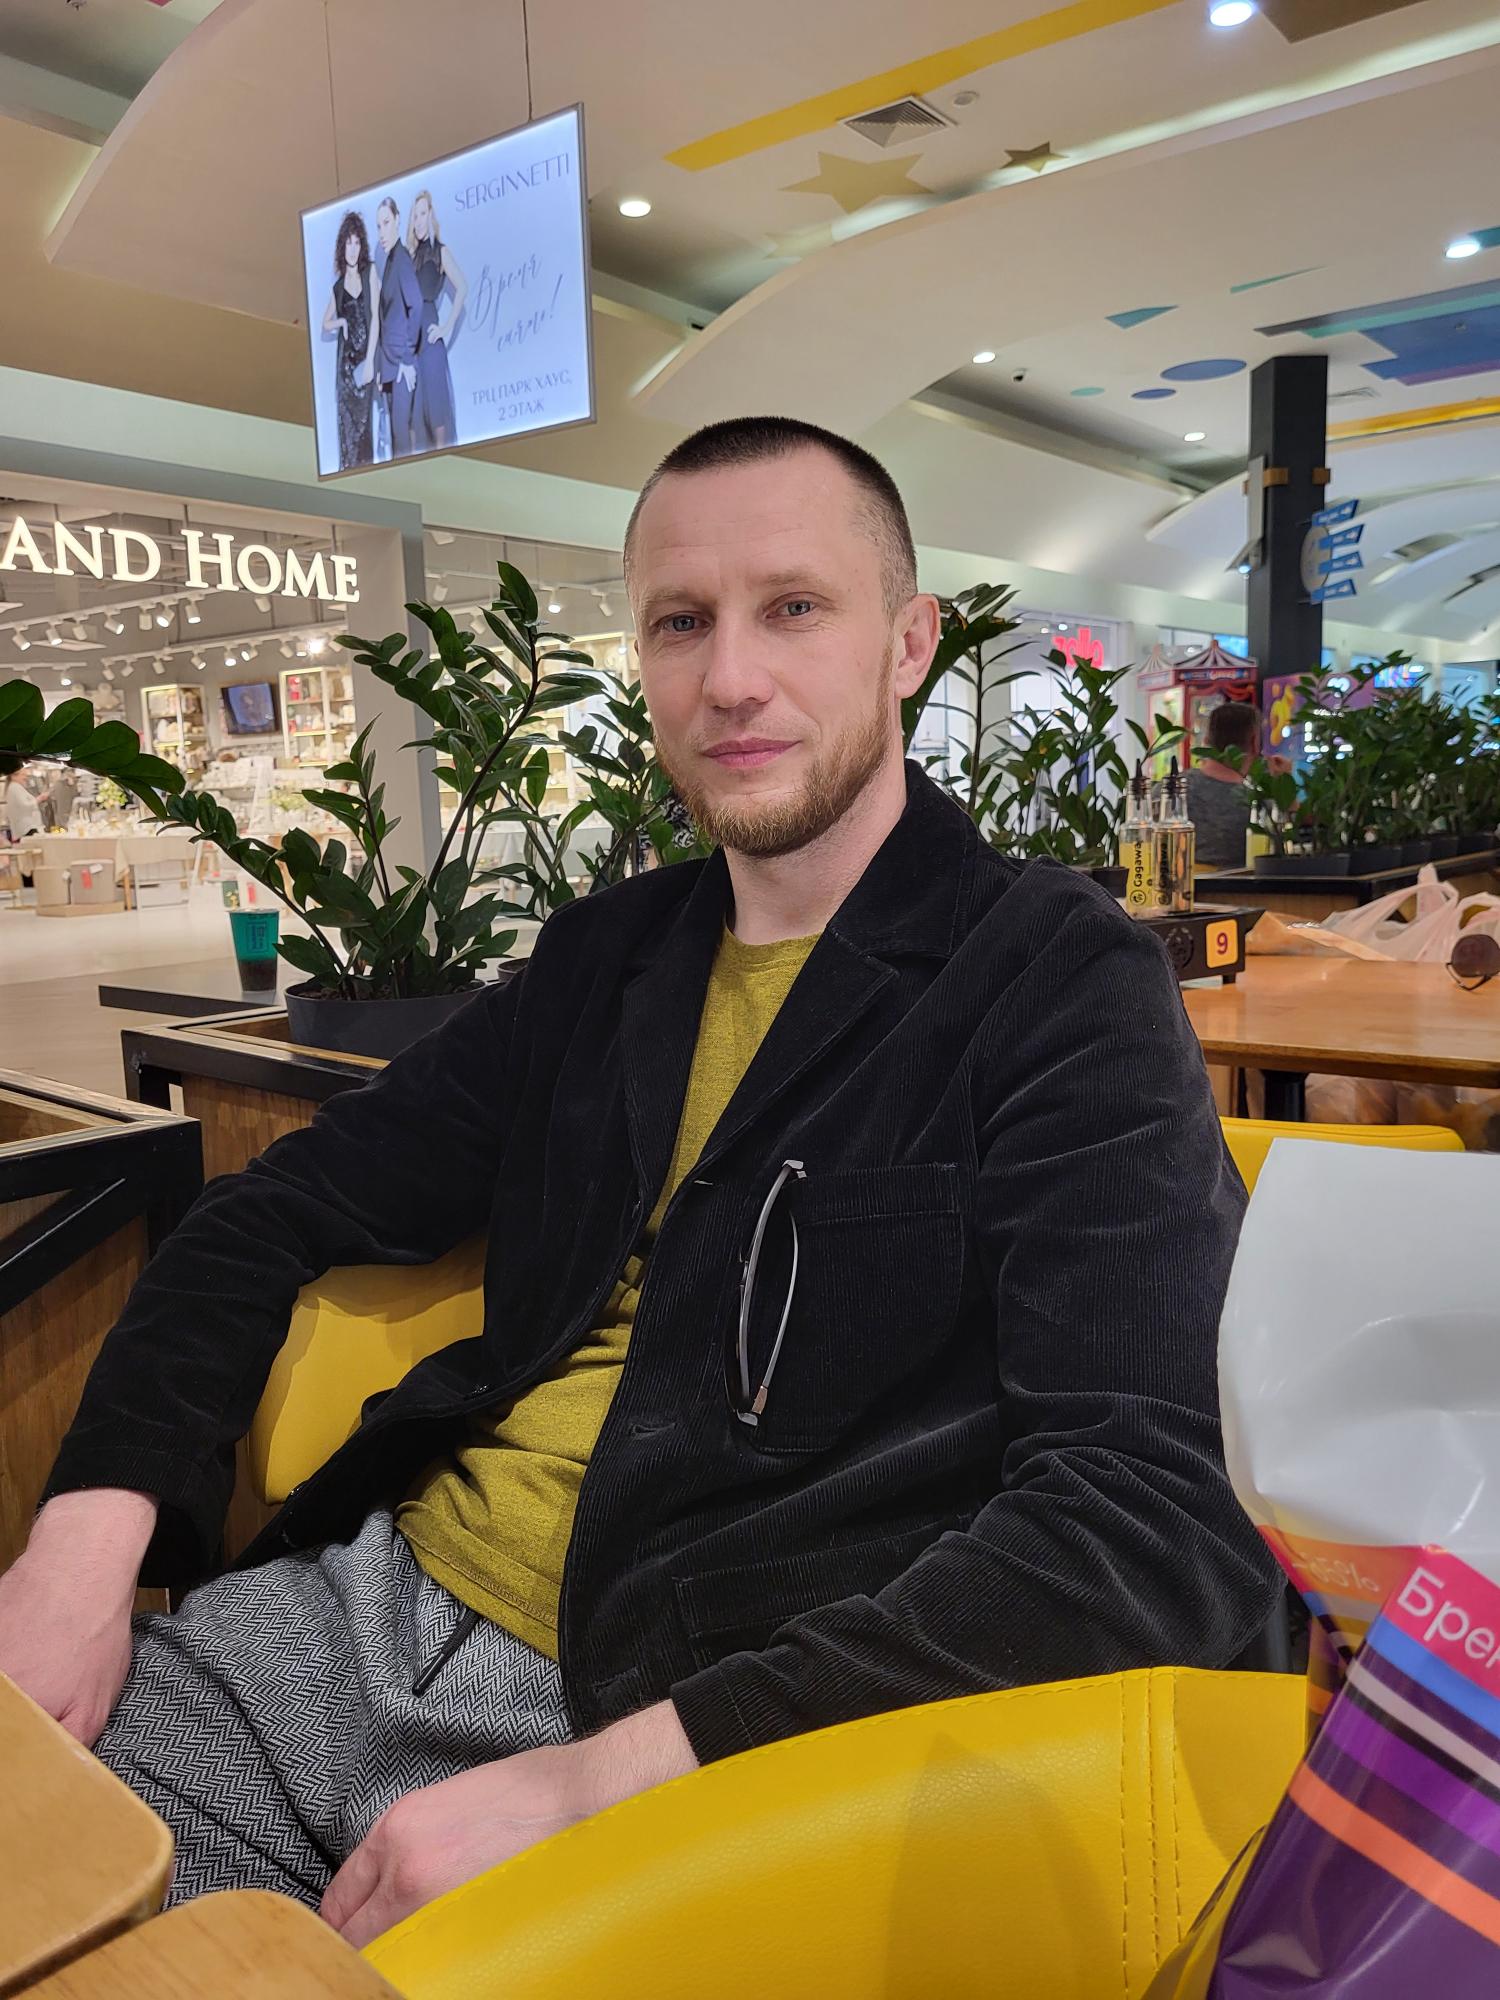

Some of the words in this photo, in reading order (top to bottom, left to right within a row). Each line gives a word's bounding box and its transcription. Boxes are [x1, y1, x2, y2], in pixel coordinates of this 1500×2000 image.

[455, 153, 569, 212] SERGINNETTI
[472, 387, 496, 406] ТРЦ
[498, 379, 532, 400] ПАРК
[498, 407, 505, 421] 2
[508, 399, 545, 419] ЭТАЖ
[0, 515, 161, 583] AND
[180, 528, 360, 603] HOME
[1217, 932, 1228, 955] 9
